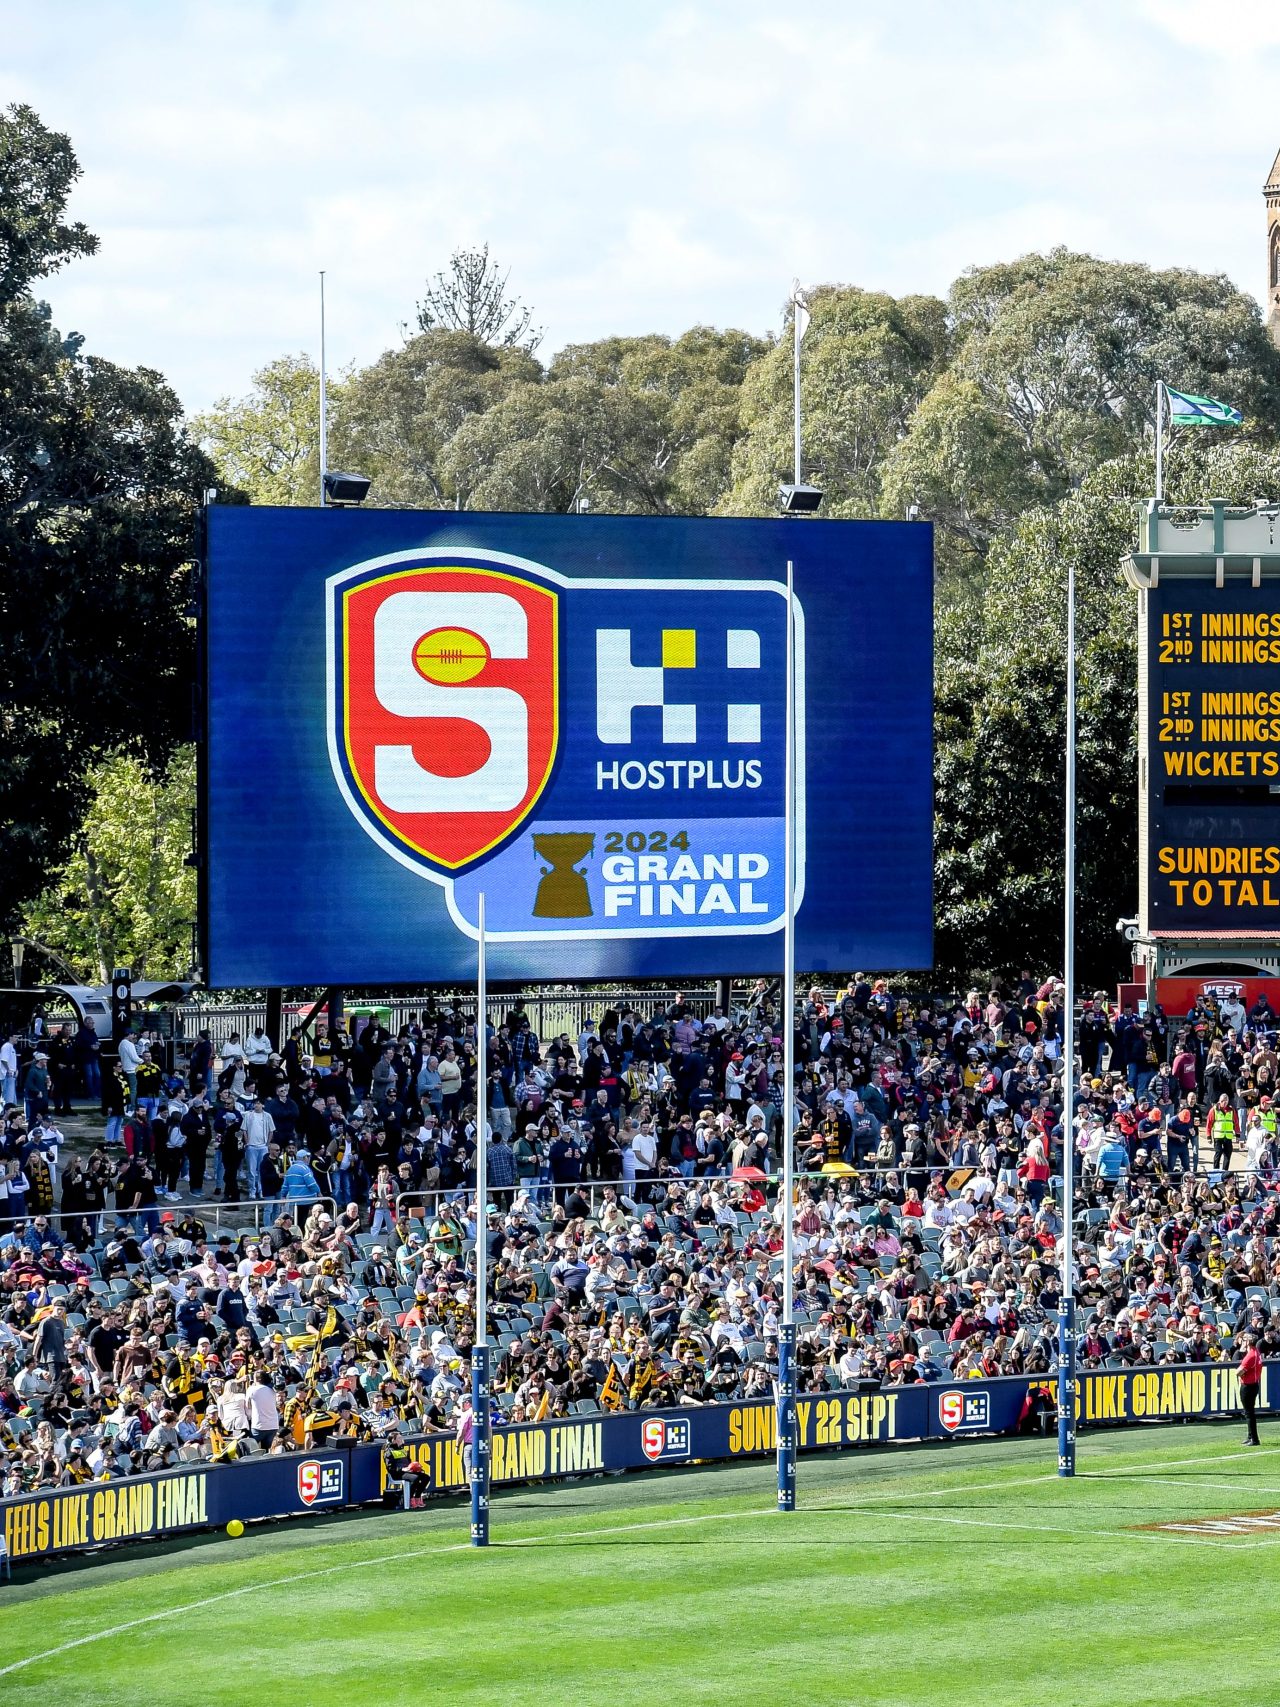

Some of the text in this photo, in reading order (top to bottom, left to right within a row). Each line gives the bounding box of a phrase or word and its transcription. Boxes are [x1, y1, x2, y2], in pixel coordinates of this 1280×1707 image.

[1163, 613, 1193, 637] 1ST
[1158, 640, 1193, 663] 2ND
[1163, 691, 1191, 715] 1ST
[1158, 718, 1194, 742] 2ND
[597, 760, 762, 790] HOSTPLUS
[1163, 751, 1279, 777] WICKETS
[604, 831, 689, 853] 2024
[602, 854, 770, 882] GRAND
[1158, 847, 1280, 873] SUNDRIES
[603, 883, 770, 917] FINAL
[1169, 880, 1280, 906] TOTAL
[1085, 1375, 1128, 1420] LIKE
[1132, 1370, 1206, 1417] GRAND
[1210, 1366, 1271, 1411] FINL
[816, 1399, 842, 1445] 22
[847, 1394, 899, 1442] SEPT
[550, 1423, 604, 1474] FINAL
[5, 1473, 208, 1557] FEELS LIKE GRAND FINAL
